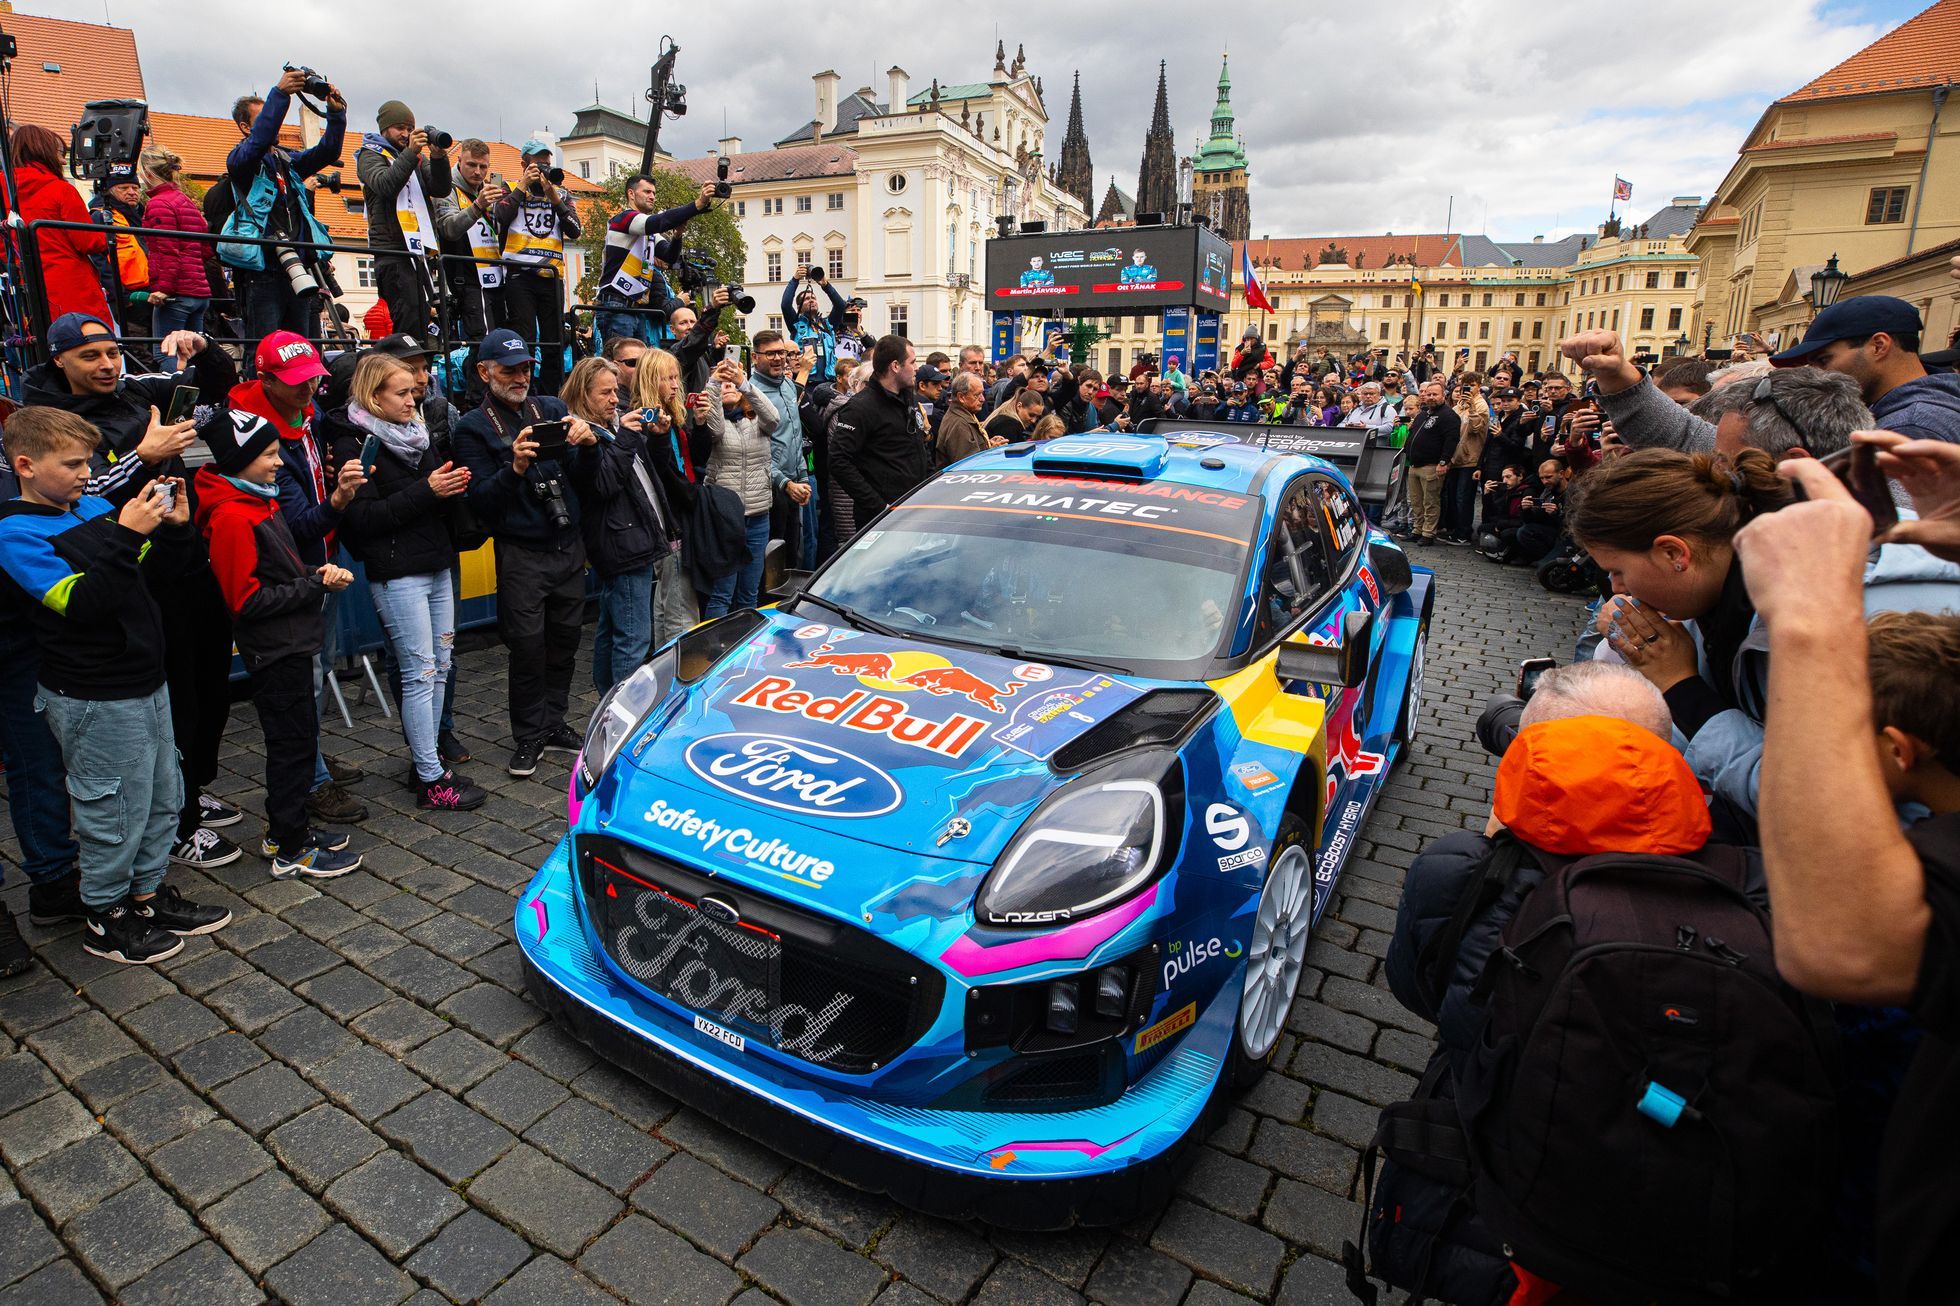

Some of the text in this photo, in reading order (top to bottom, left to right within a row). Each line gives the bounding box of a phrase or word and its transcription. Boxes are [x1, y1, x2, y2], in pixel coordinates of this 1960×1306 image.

[524, 212, 553, 229] 268
[1050, 250, 1084, 259] WRC
[1010, 287, 1032, 295] Martin
[1129, 283, 1156, 291] TÄNAK
[843, 341, 857, 353] 41
[837, 422, 856, 431] ECURITY
[1255, 443, 1319, 451] YBRID
[937, 473, 1248, 510] FORD PERFORMANCE
[960, 491, 1171, 520] FANATEC
[799, 626, 823, 638] E
[1020, 665, 1046, 679] E
[734, 676, 989, 757] Red Bull
[1068, 711, 1095, 723] 8
[1002, 723, 1033, 740] WRC
[710, 739, 867, 806] Ford
[1337, 800, 1362, 831] HYBRID
[643, 800, 835, 881] SafetyCulture
[1219, 848, 1263, 870] sparco
[703, 903, 730, 921] Ford
[988, 908, 1071, 923] LAZER
[1168, 940, 1182, 954] bp
[1163, 937, 1221, 991] pulse
[617, 891, 854, 1062] Ford
[697, 1017, 742, 1048] YX22 FCD
[1139, 1008, 1192, 1049] PIRELLI
